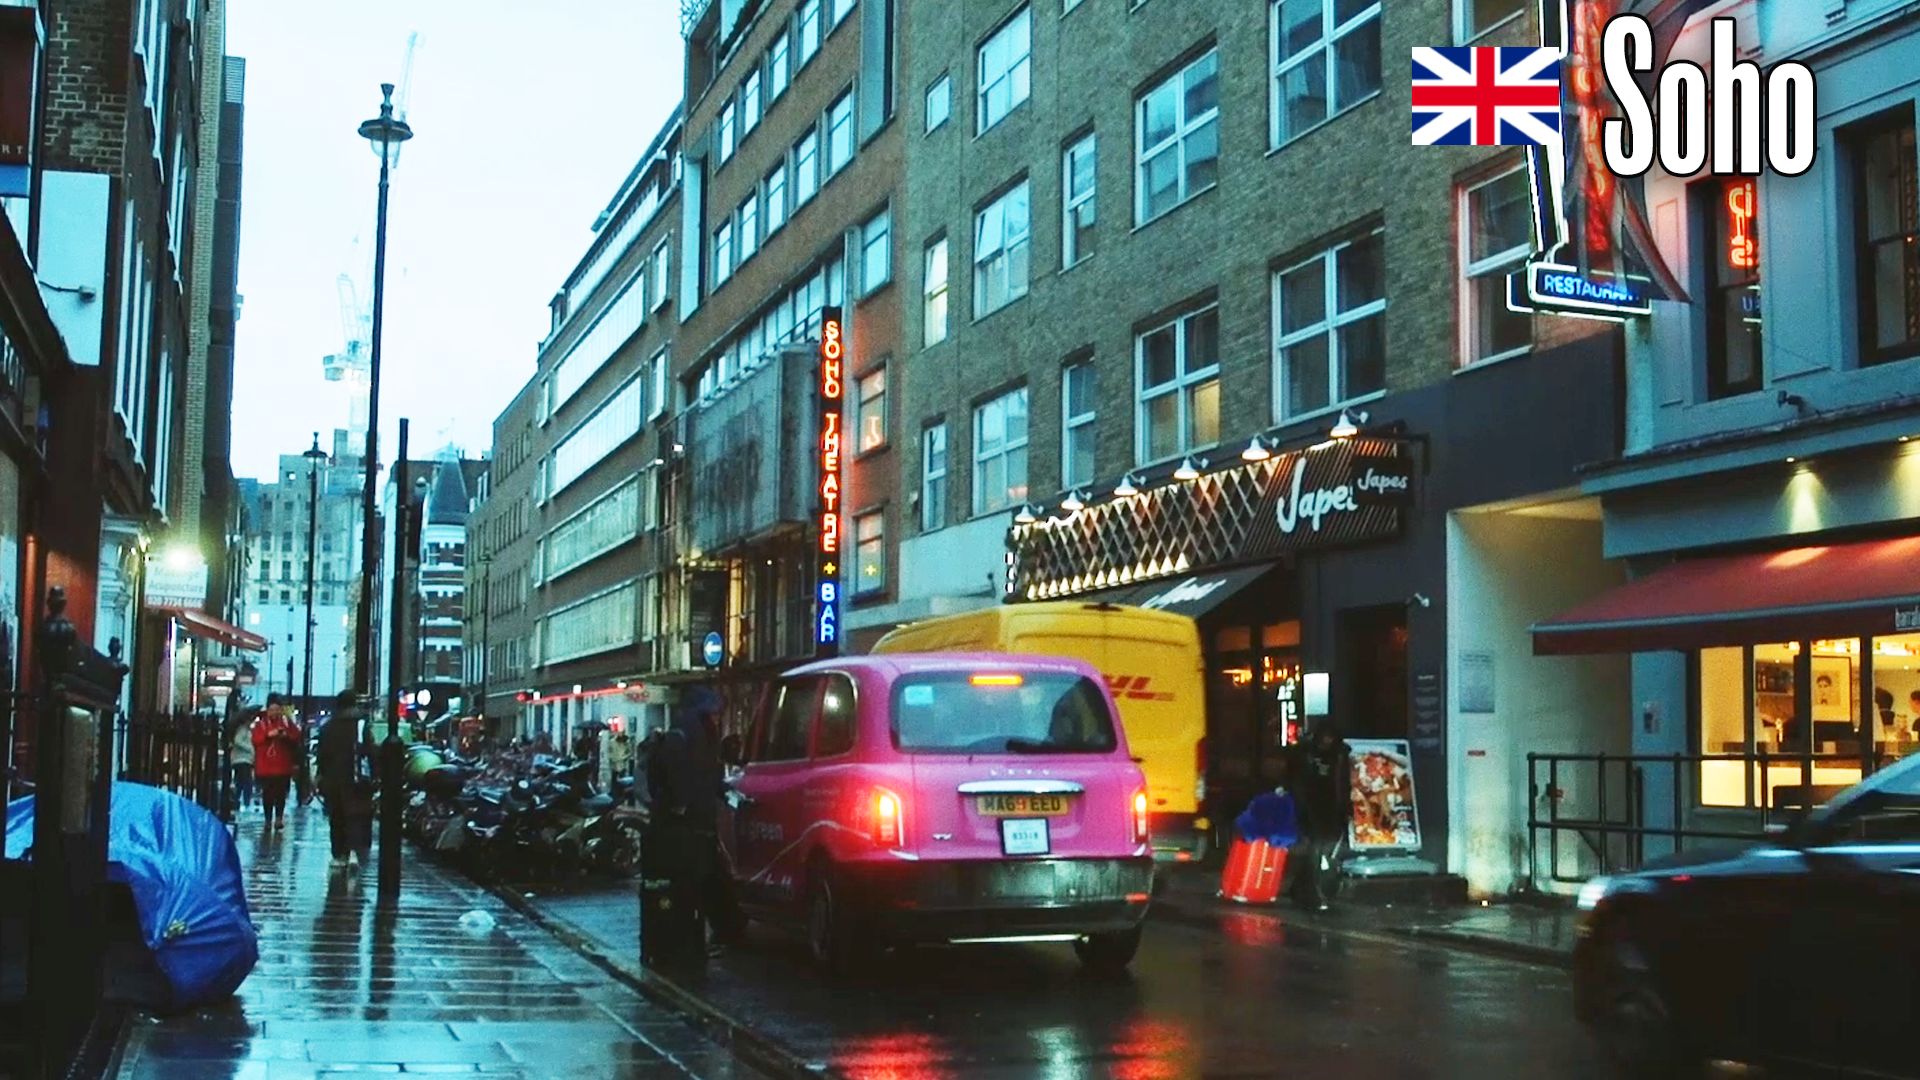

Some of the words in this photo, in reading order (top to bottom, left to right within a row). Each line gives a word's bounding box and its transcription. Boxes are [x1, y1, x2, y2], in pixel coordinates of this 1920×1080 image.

[1544, 274, 1636, 301] RESTAURAN
[823, 320, 841, 398] SOHO
[822, 413, 840, 553] THEATRE
[1357, 467, 1409, 495] Japes
[820, 582, 837, 644] BAR
[1101, 674, 1155, 700] HL
